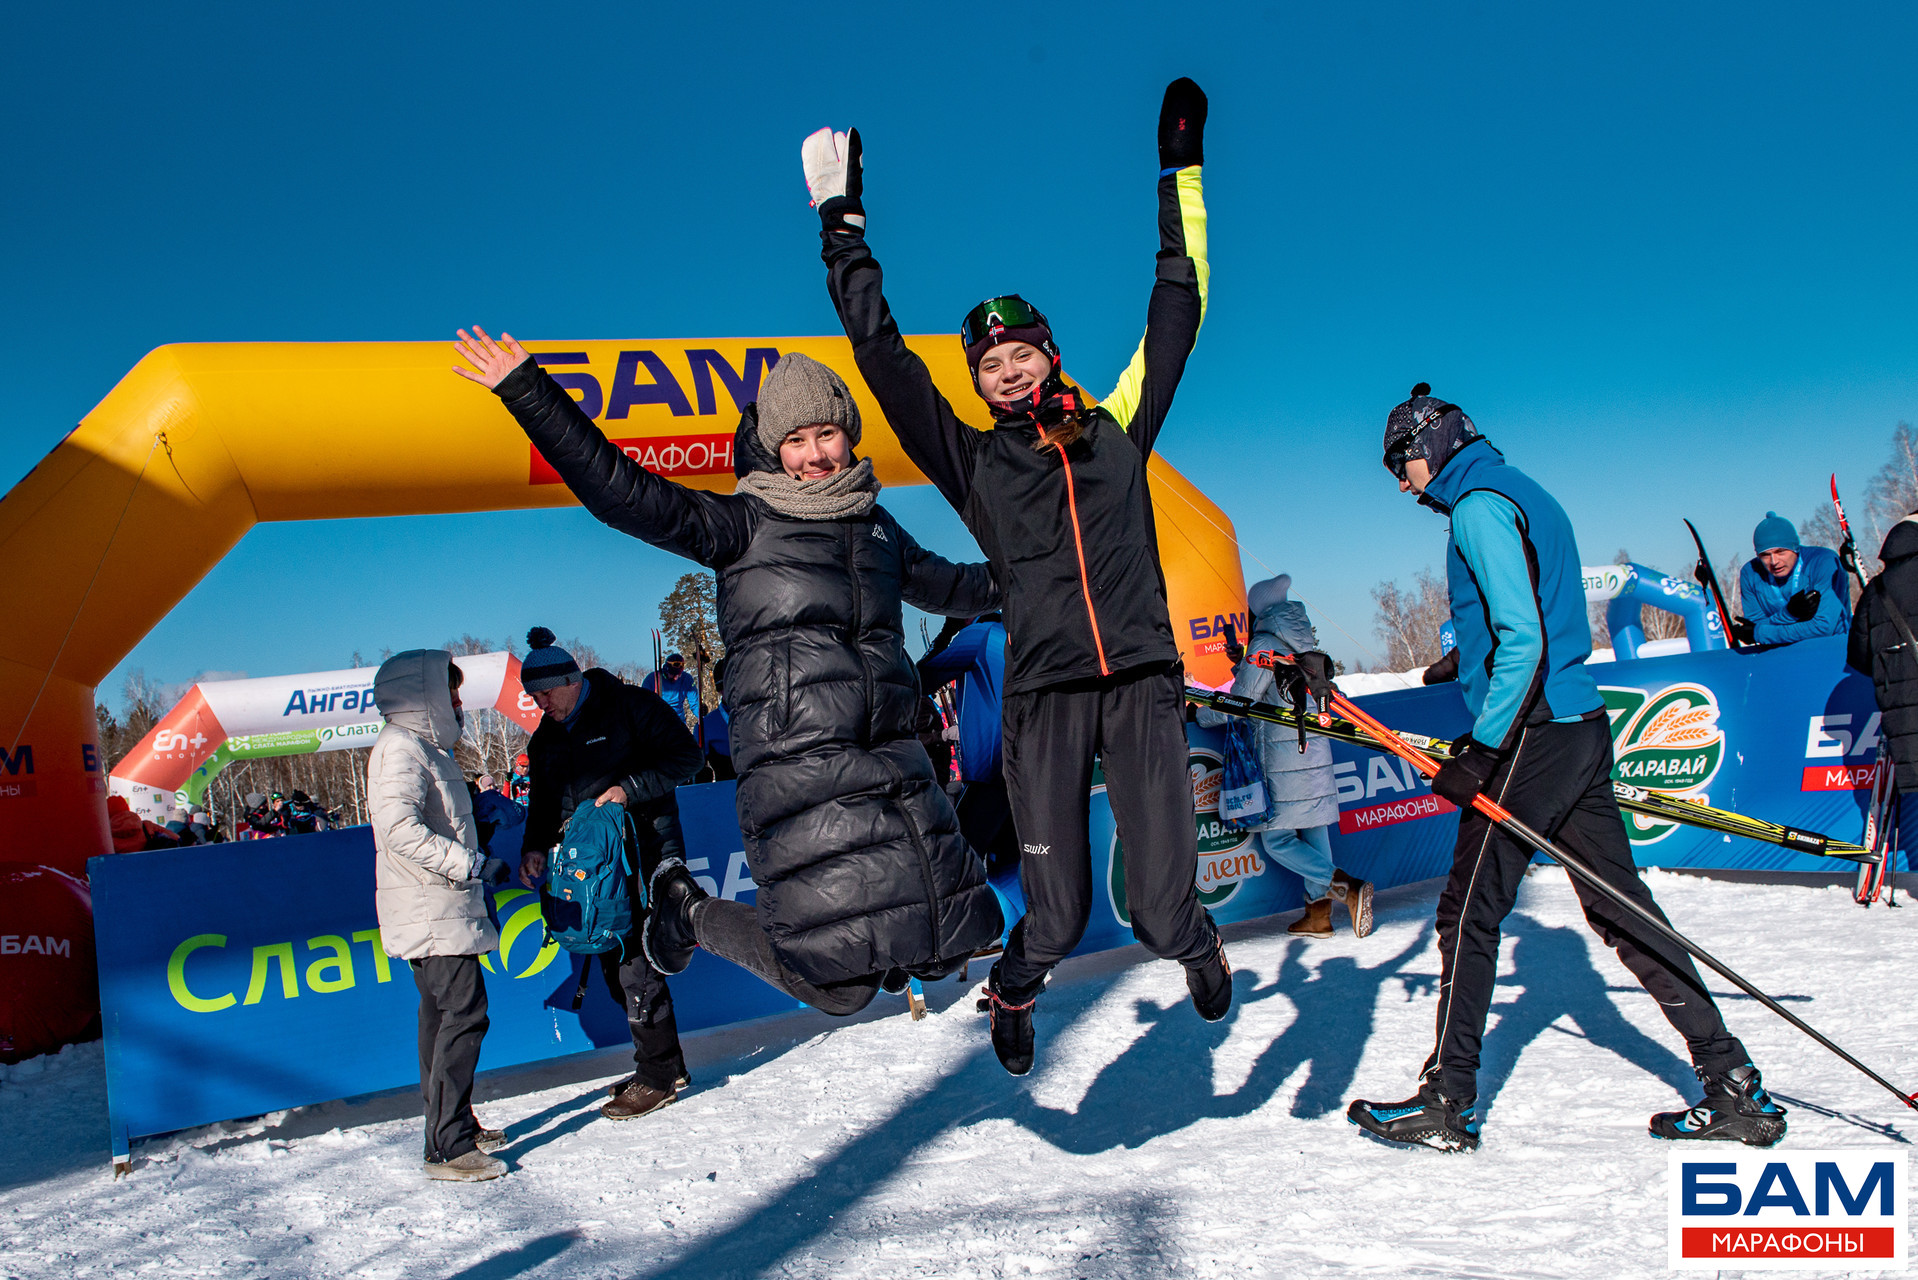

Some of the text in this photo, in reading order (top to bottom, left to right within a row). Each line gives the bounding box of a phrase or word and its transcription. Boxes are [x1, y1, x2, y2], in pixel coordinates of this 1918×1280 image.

[623, 441, 735, 472] РАФОН
[1582, 576, 1603, 590] ата
[282, 687, 376, 717] Ангар
[336, 723, 380, 737] Слата
[1805, 711, 1882, 759] БА
[1618, 754, 1708, 778] КАРАВАЙ
[1355, 796, 1439, 828] МАРАФОНЫ
[1203, 853, 1261, 883] лет
[0, 934, 71, 959] БАМ
[166, 928, 392, 1013] Слат
